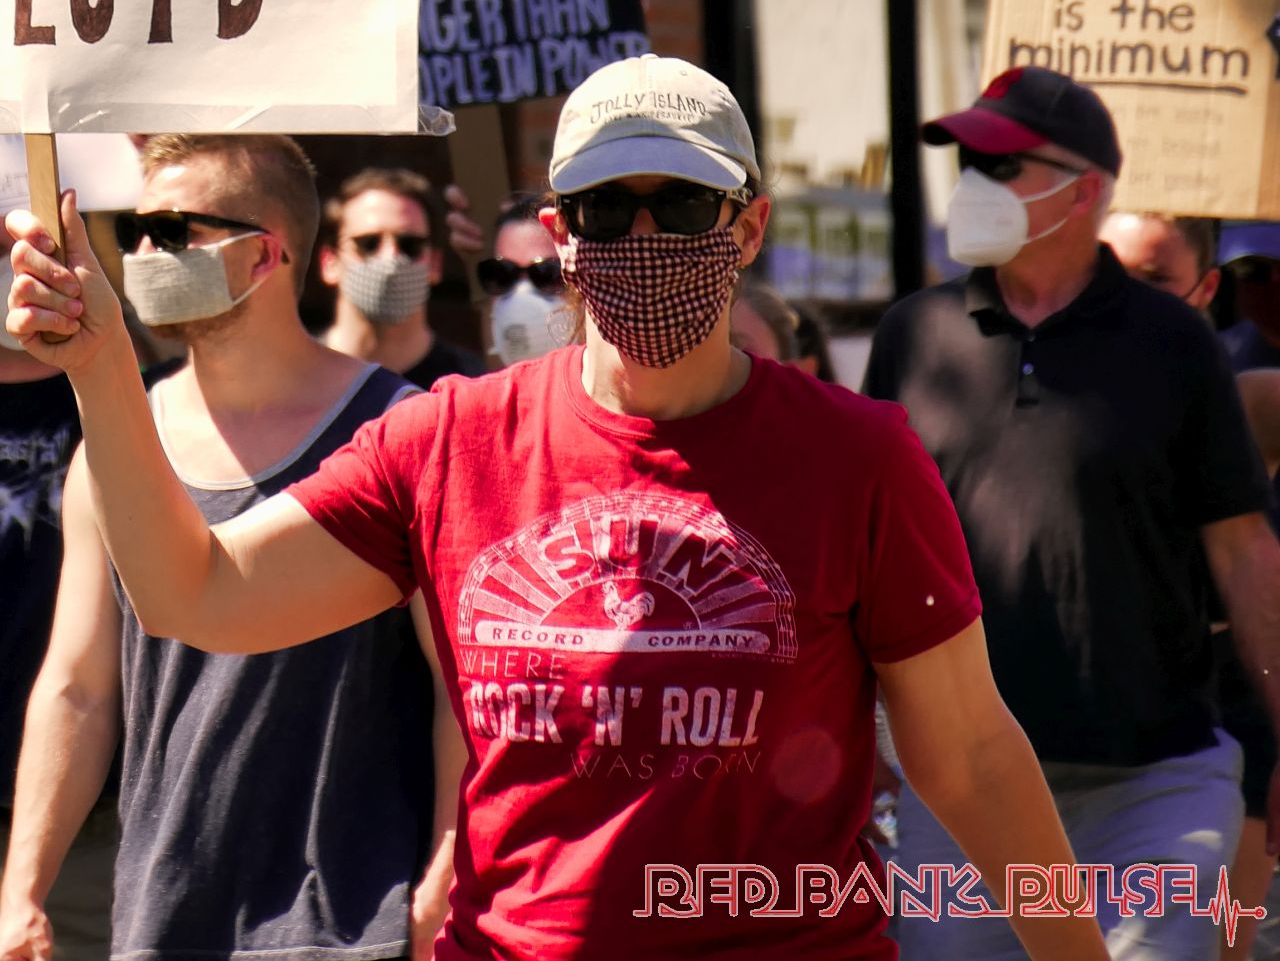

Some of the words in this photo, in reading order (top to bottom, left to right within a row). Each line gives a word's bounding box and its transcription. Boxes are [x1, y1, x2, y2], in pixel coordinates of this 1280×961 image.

[1008, 38, 1250, 77] minimum
[543, 513, 749, 597] SUN
[492, 627, 585, 647] RECORD
[647, 632, 755, 649] COMPANY
[460, 650, 566, 681] WHERE
[469, 680, 565, 744] ROCK
[660, 686, 764, 747] ROLL
[570, 752, 656, 780] WAS
